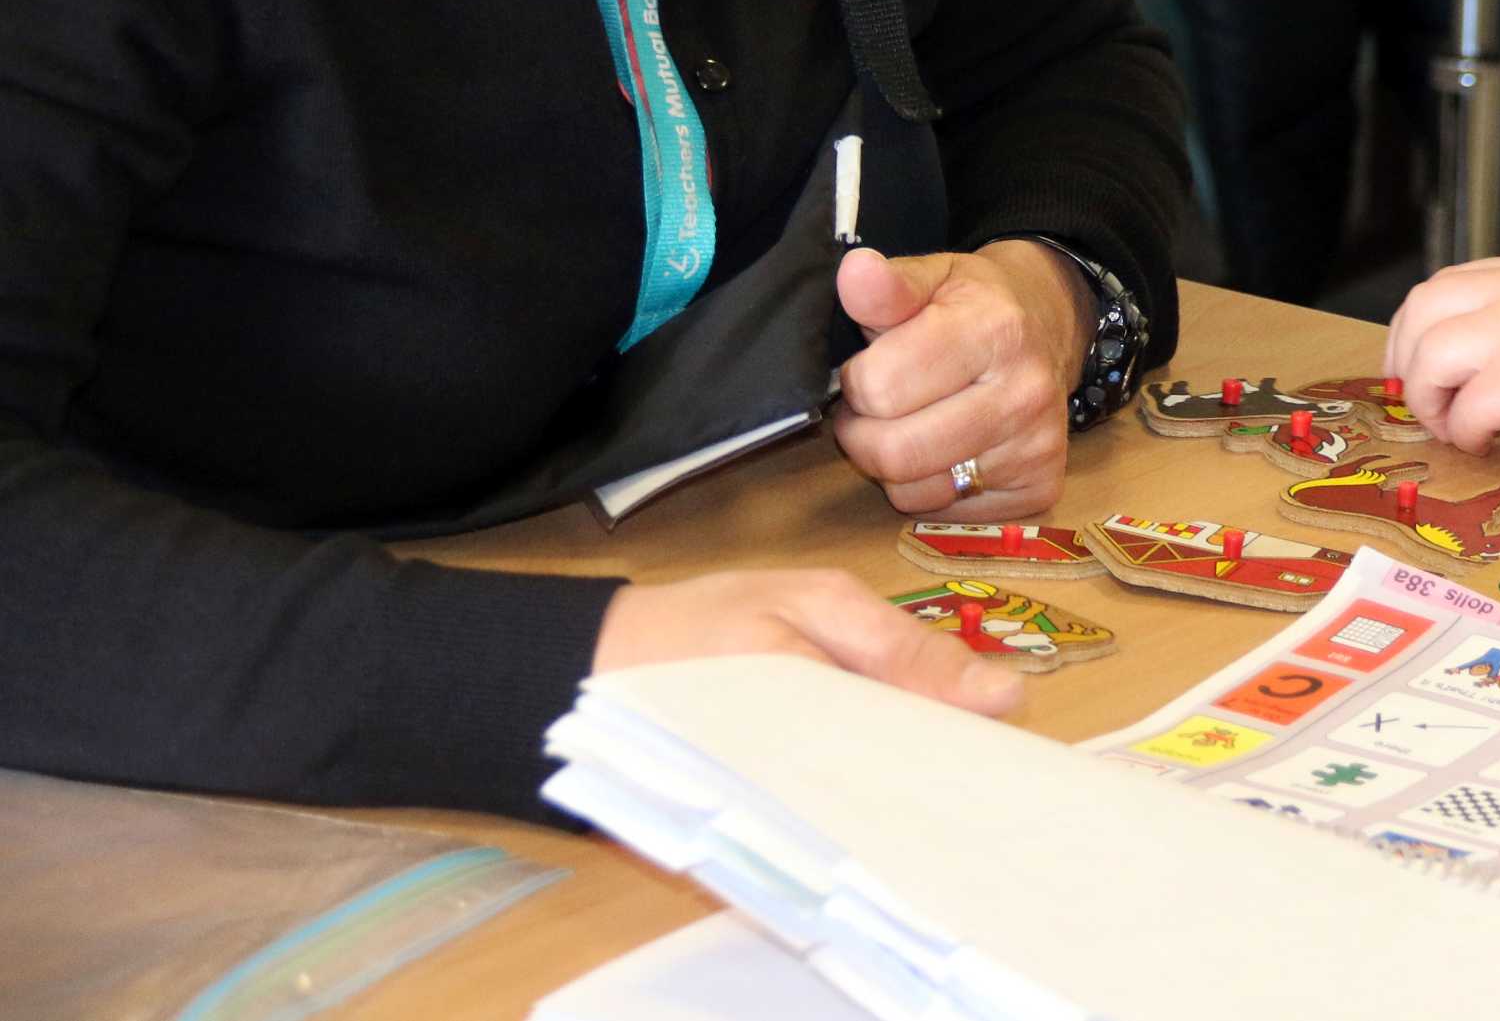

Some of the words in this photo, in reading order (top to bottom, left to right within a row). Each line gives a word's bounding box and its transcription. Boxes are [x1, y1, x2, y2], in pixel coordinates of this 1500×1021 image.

[647, 31, 686, 119] Mutual
[675, 124, 698, 241] Teachers
[1393, 568, 1436, 597] 38a
[1443, 588, 1494, 615] dolls
